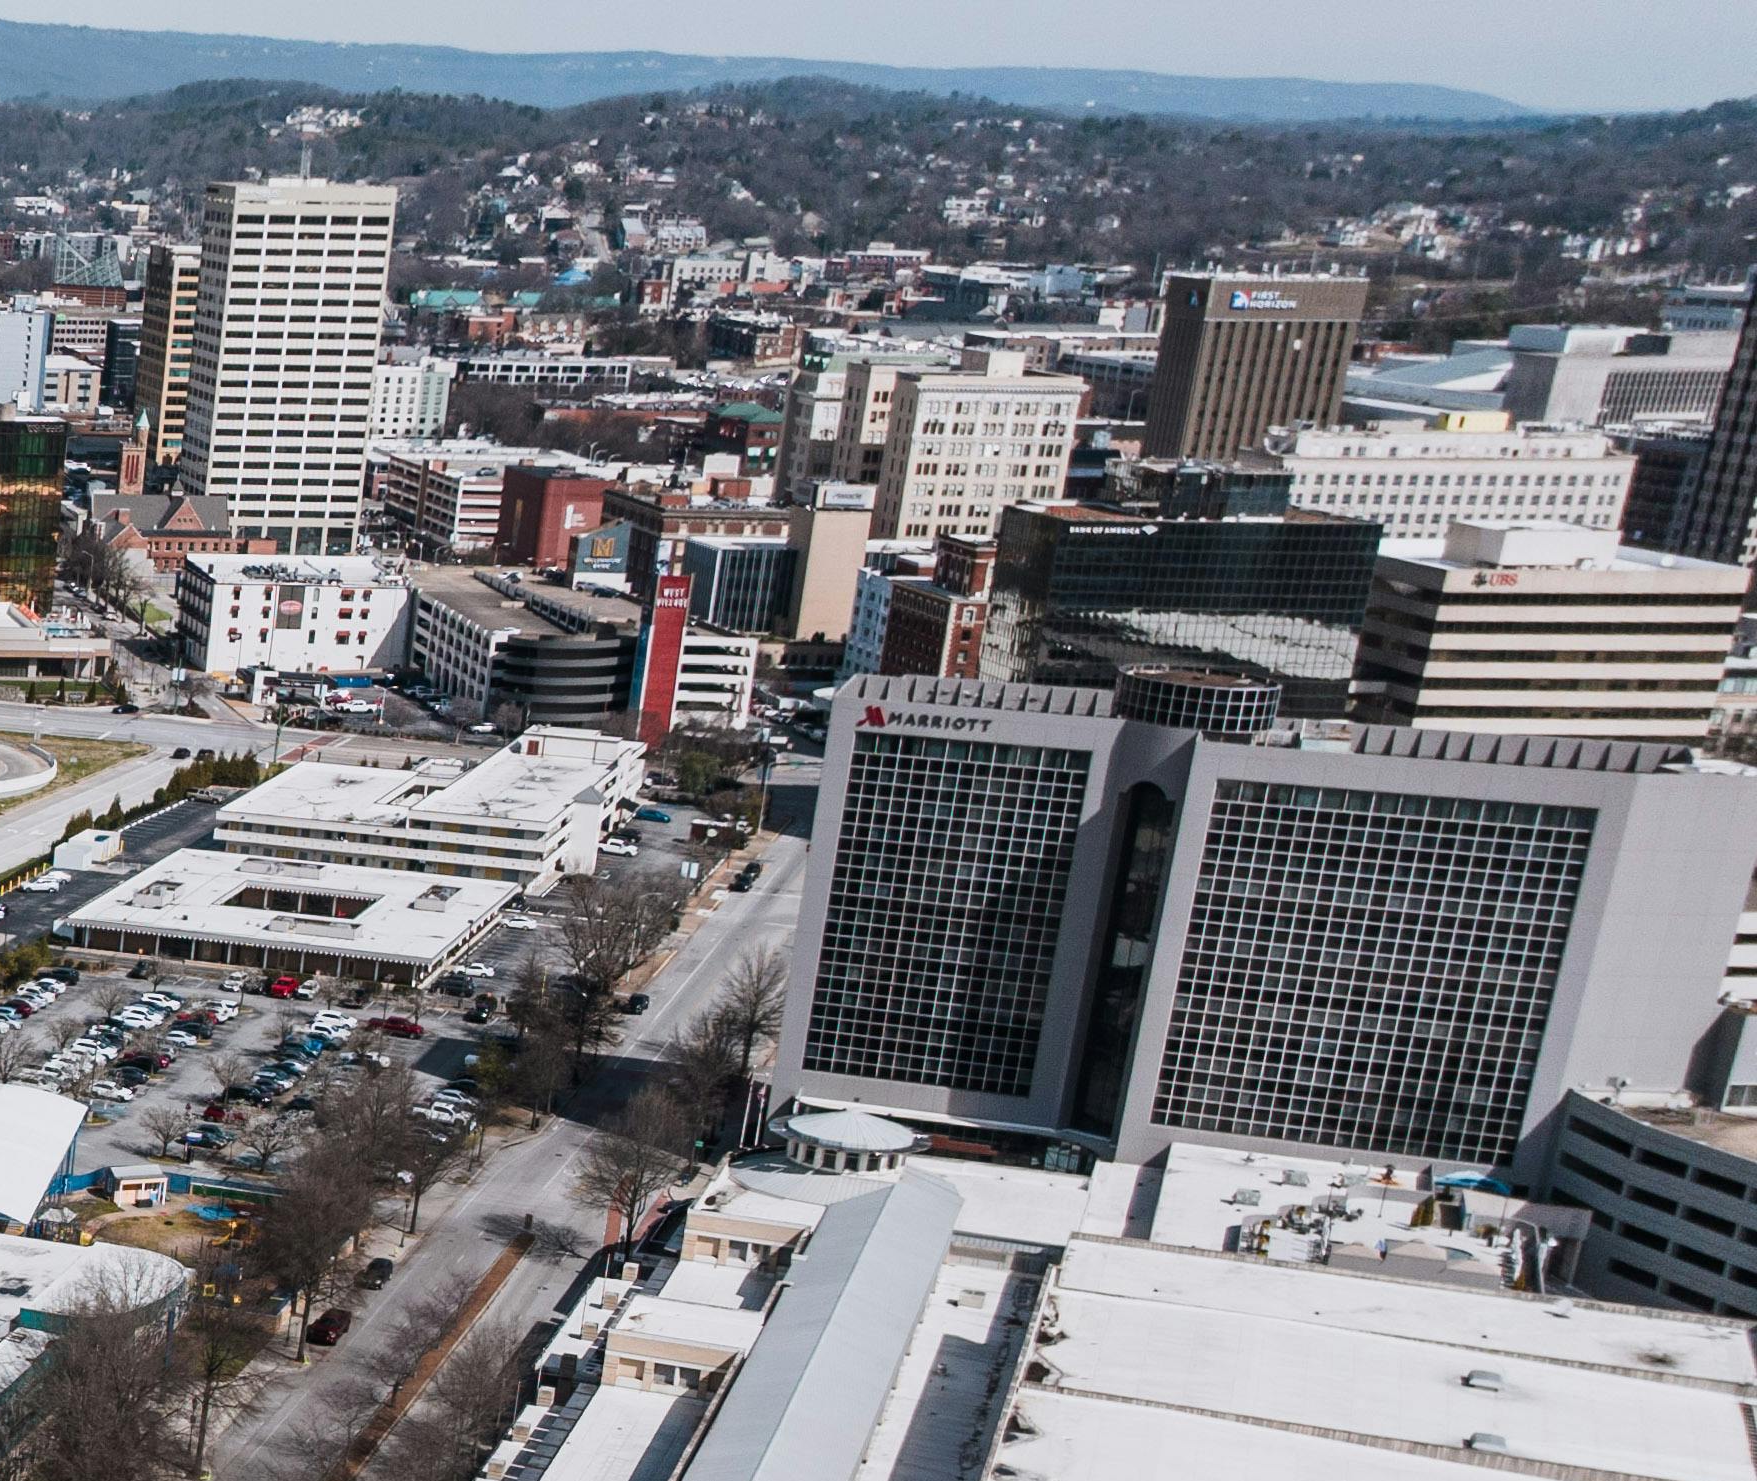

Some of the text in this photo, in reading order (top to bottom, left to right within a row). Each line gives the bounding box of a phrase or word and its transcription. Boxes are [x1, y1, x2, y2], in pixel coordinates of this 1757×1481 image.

[1250, 291, 1281, 300] FIRST
[1249, 300, 1297, 309] HORIZON
[1069, 526, 1141, 535] BANK OF AMERICA
[1489, 572, 1518, 587] UBS
[663, 587, 685, 598] WEST
[887, 711, 992, 732] MARRIOTT
